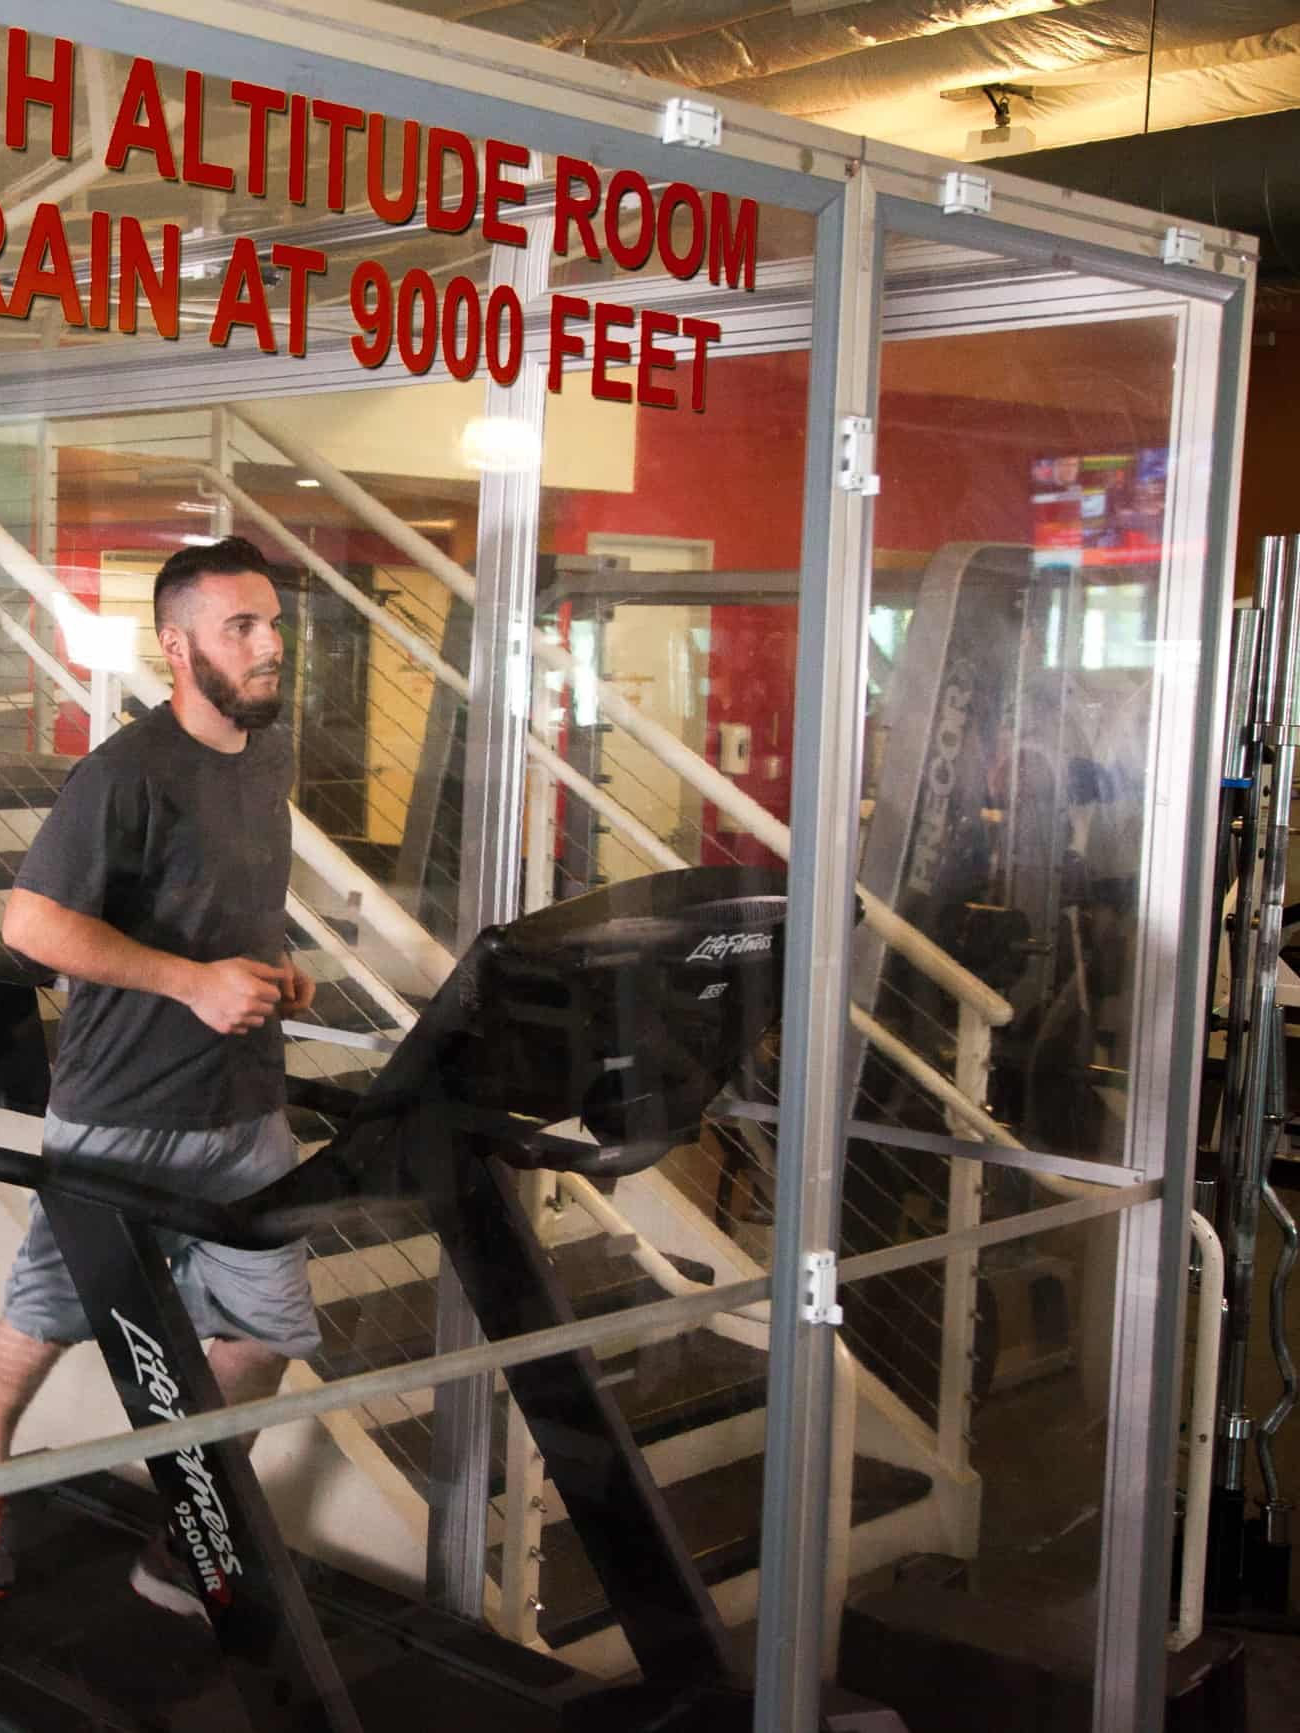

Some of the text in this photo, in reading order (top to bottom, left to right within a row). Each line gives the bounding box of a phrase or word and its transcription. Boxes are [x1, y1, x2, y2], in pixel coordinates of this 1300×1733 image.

[105, 57, 529, 247] ALTITUDE
[553, 155, 758, 291] ROOM
[208, 237, 327, 358] AT
[349, 260, 524, 388] 9000
[548, 294, 721, 412] FEET
[174, 1501, 222, 1594] 9500HR
